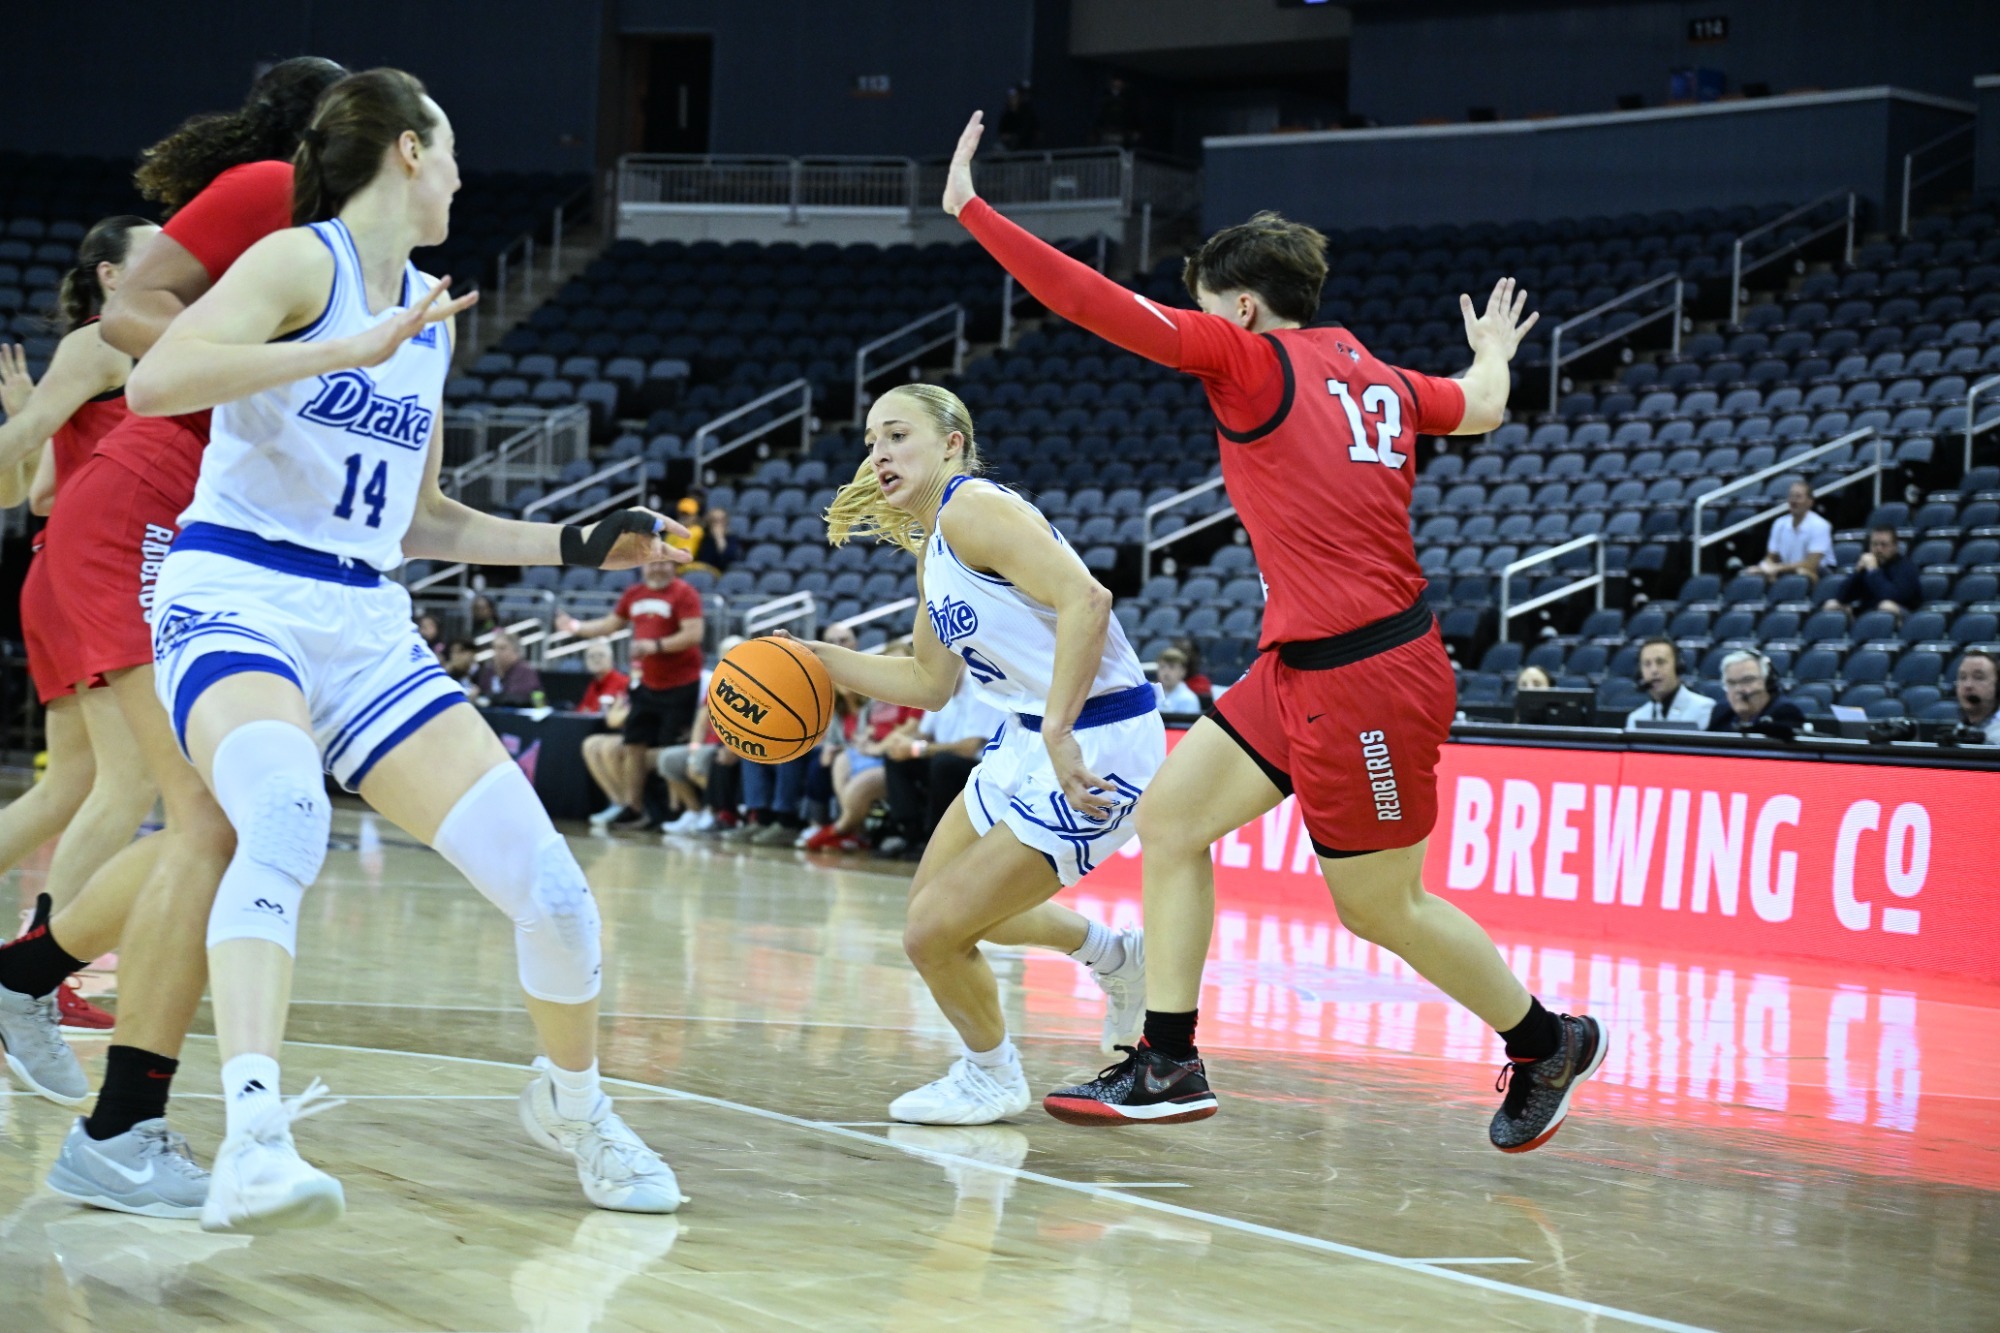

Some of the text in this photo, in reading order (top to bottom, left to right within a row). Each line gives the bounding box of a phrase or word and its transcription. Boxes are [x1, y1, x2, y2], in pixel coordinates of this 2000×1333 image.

[297, 367, 432, 451] Drake
[1326, 378, 1407, 469] 12
[333, 453, 388, 529] 14
[708, 709, 768, 757] Wilso
[716, 678, 768, 725] NCAA
[1360, 729, 1402, 820] REDBIRDS
[1447, 776, 1801, 922] BREWING
